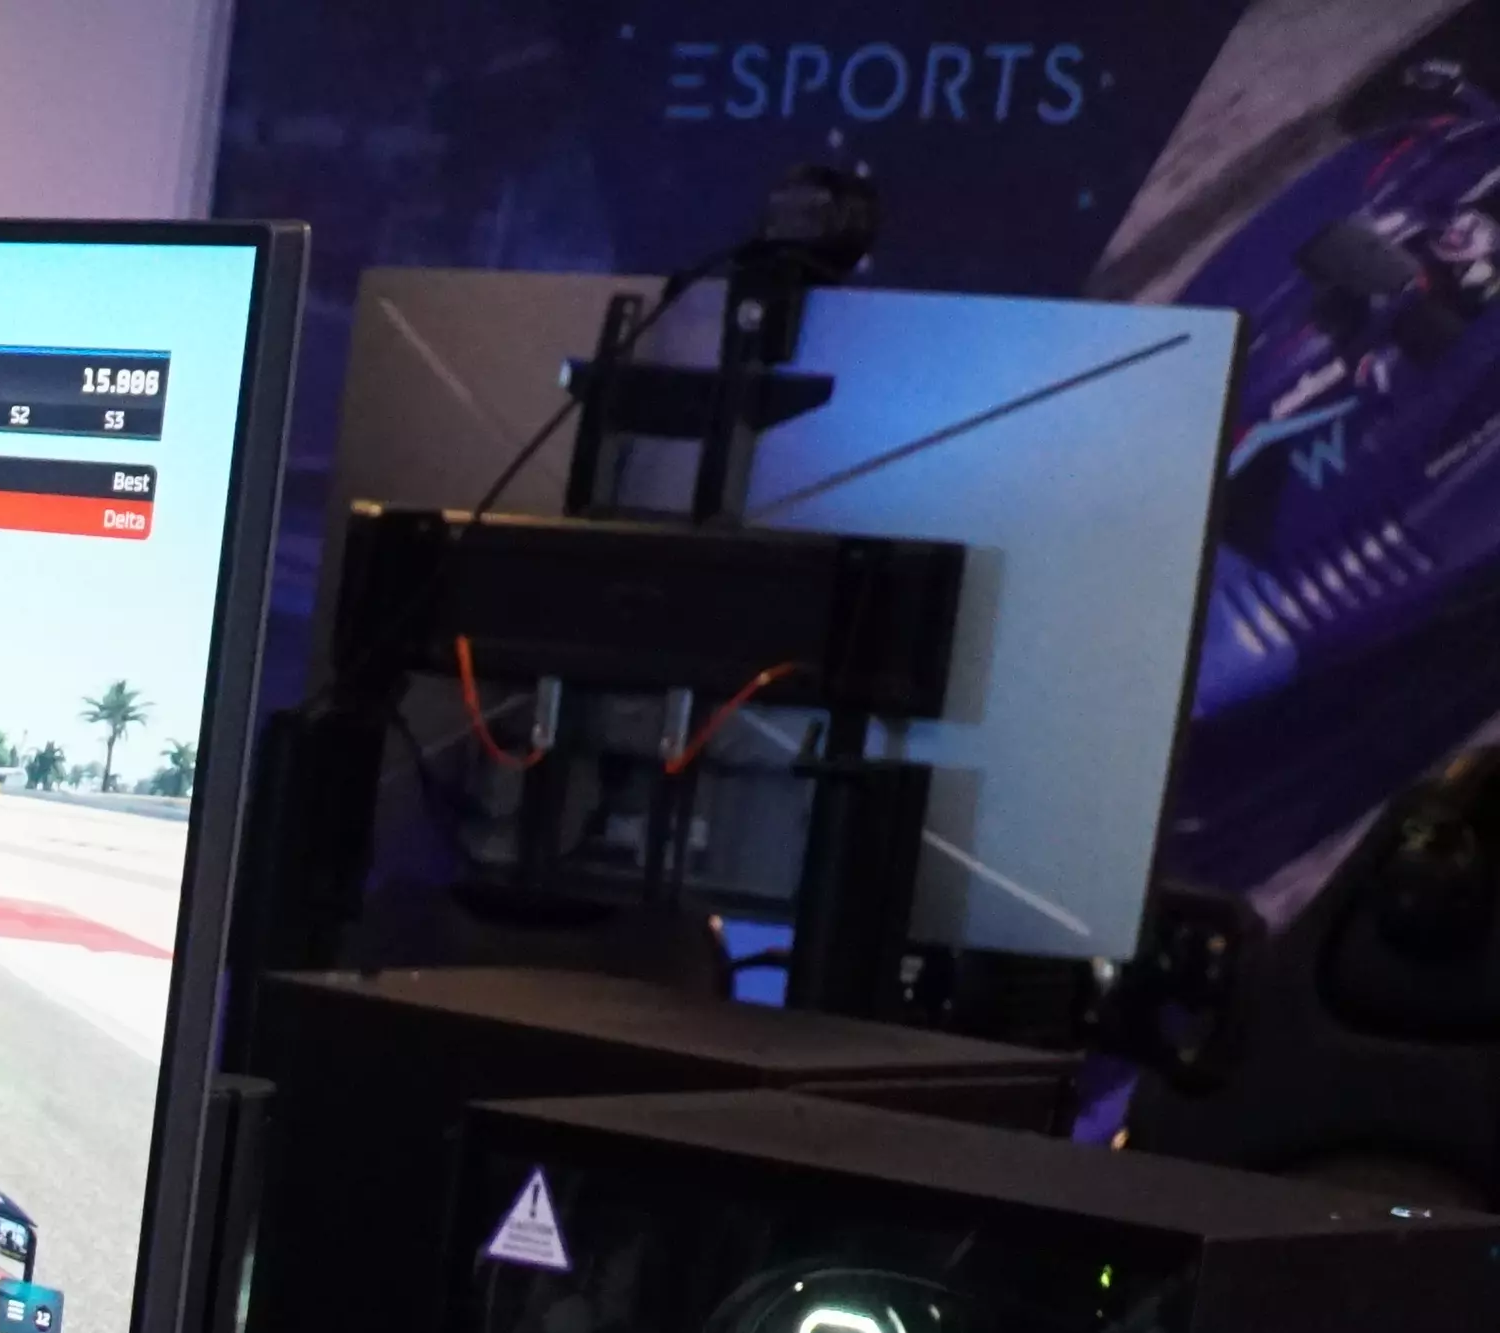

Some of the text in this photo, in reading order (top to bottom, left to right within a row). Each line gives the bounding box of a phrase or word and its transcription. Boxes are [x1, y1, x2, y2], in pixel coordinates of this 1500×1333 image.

[665, 41, 1089, 124] ESPORTS
[10, 405, 30, 424] S2
[104, 411, 124, 429] S3
[113, 472, 150, 493] Best
[103, 510, 145, 530] Delta
